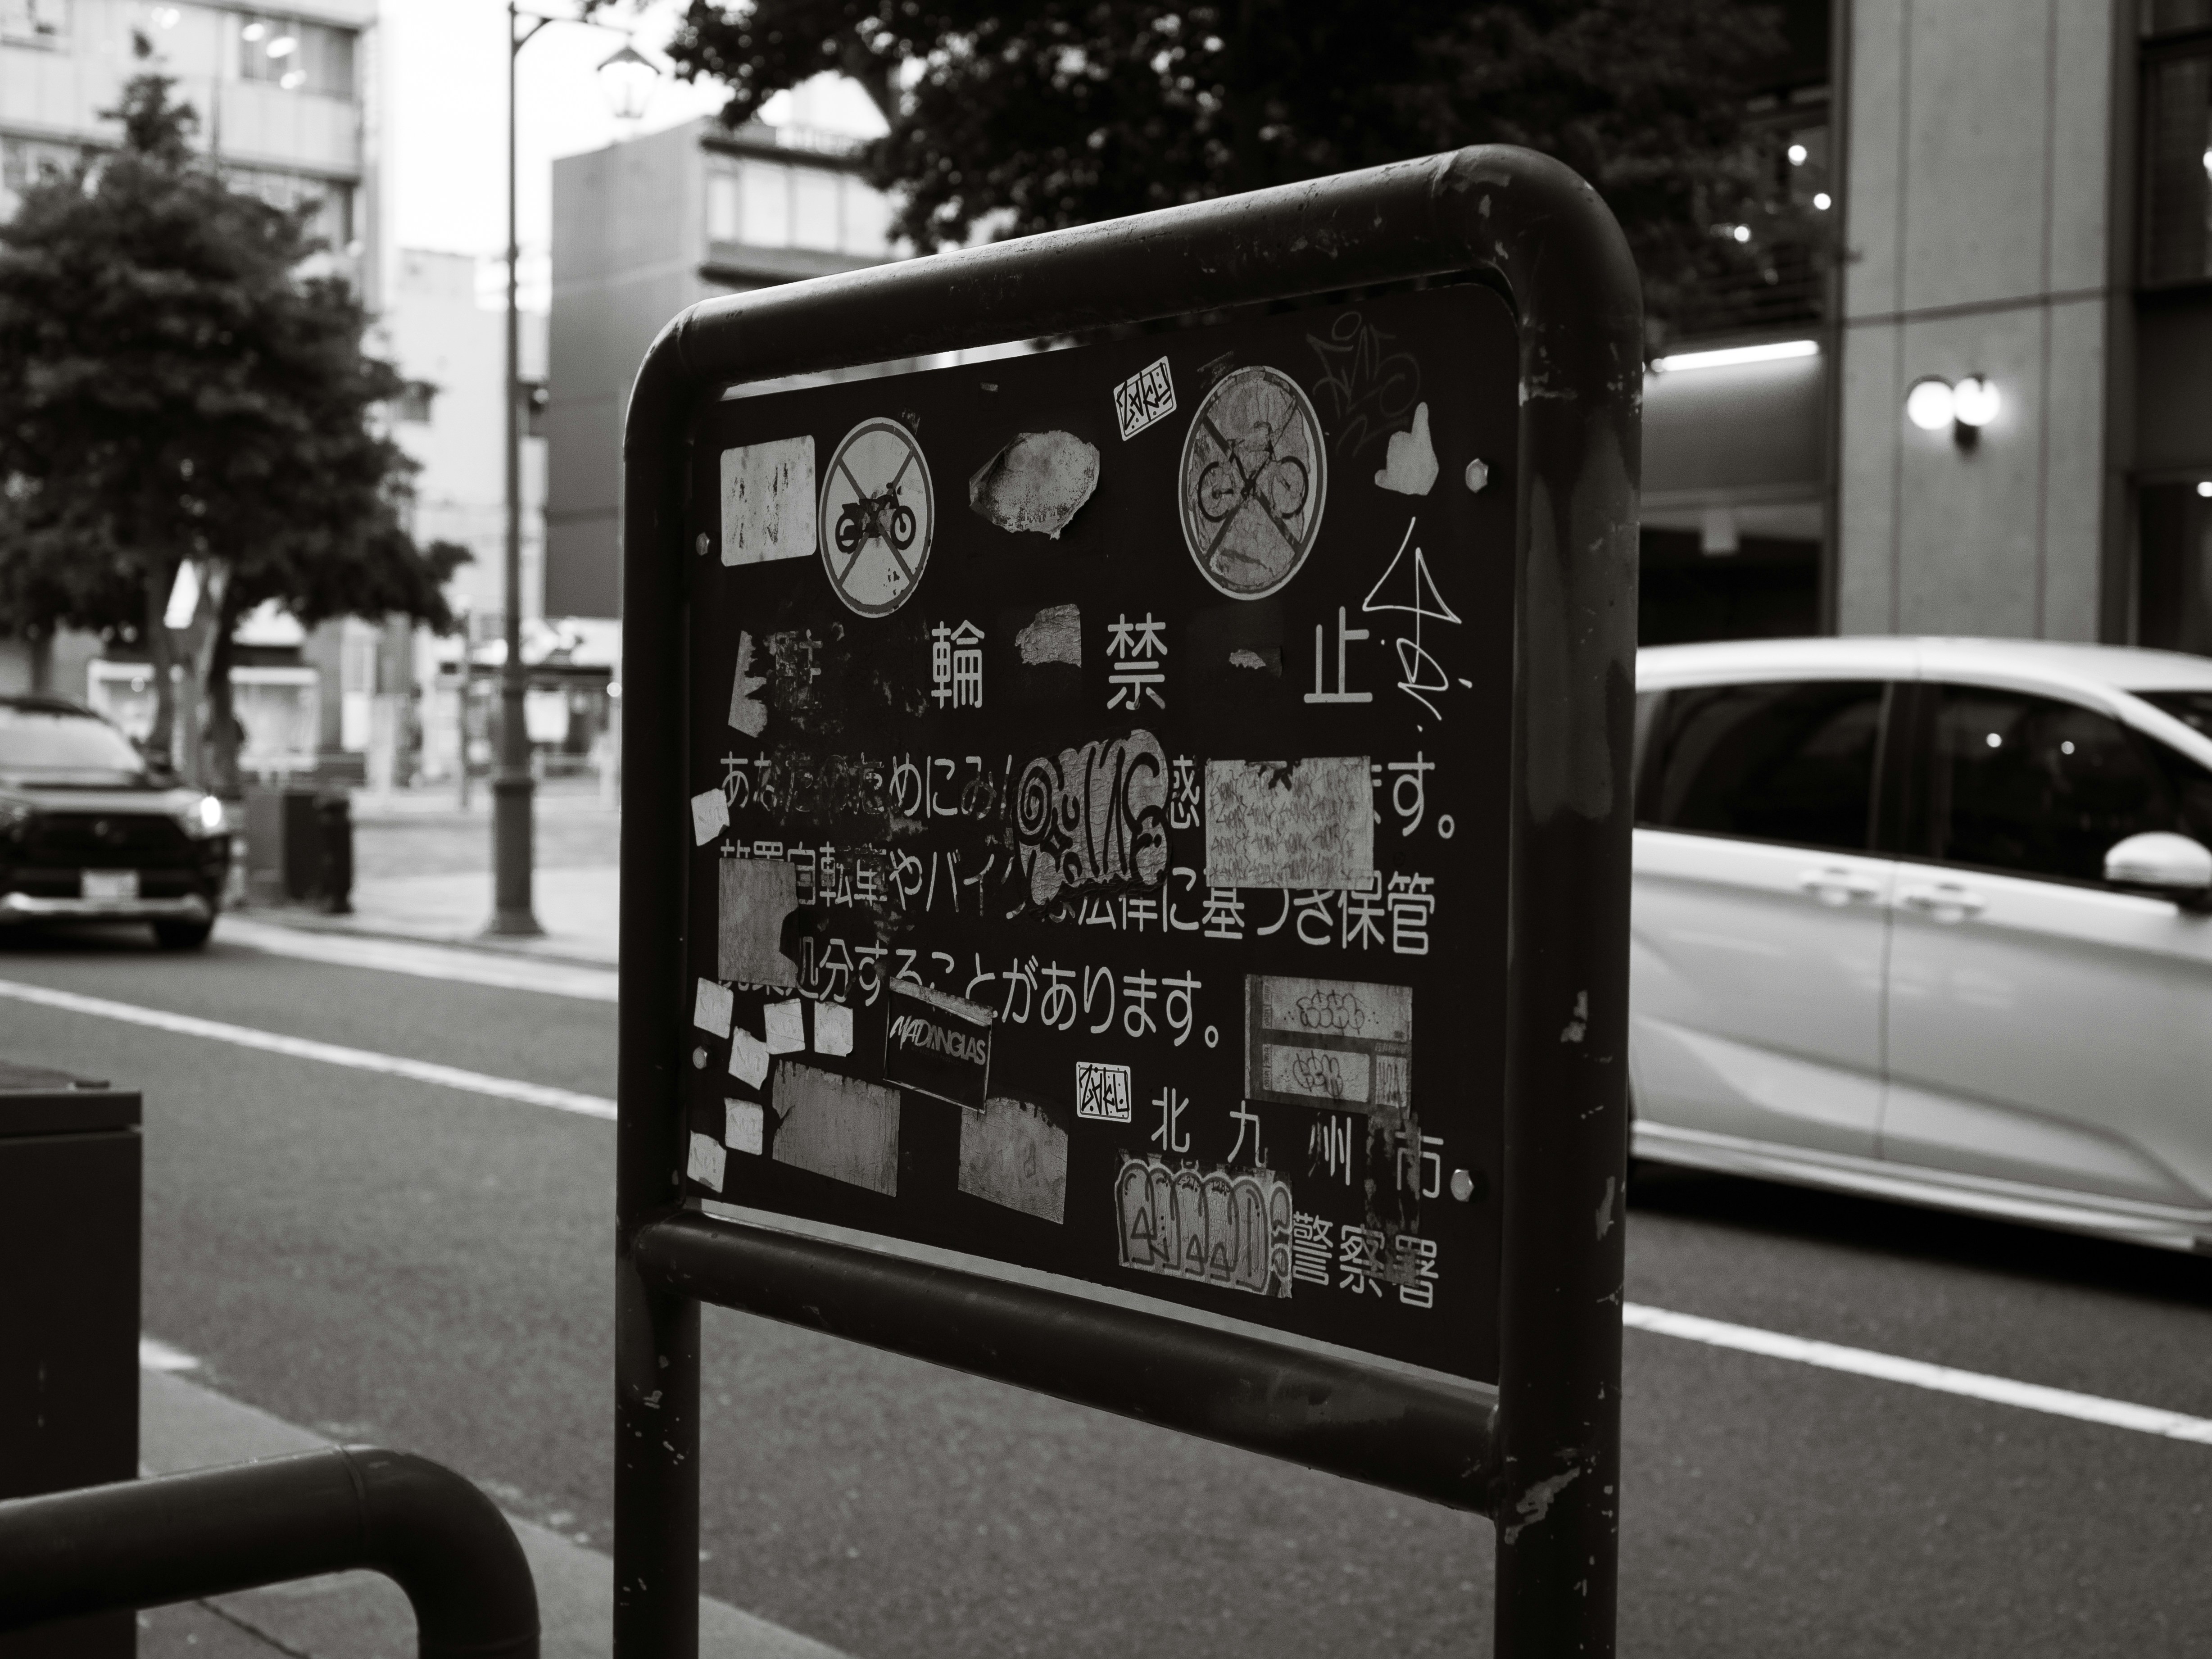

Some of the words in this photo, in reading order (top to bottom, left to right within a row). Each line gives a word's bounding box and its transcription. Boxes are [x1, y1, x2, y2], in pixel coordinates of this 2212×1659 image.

[719, 937, 1219, 1048] 処分することがあります。
[1151, 1086, 1445, 1199] 北九州市
